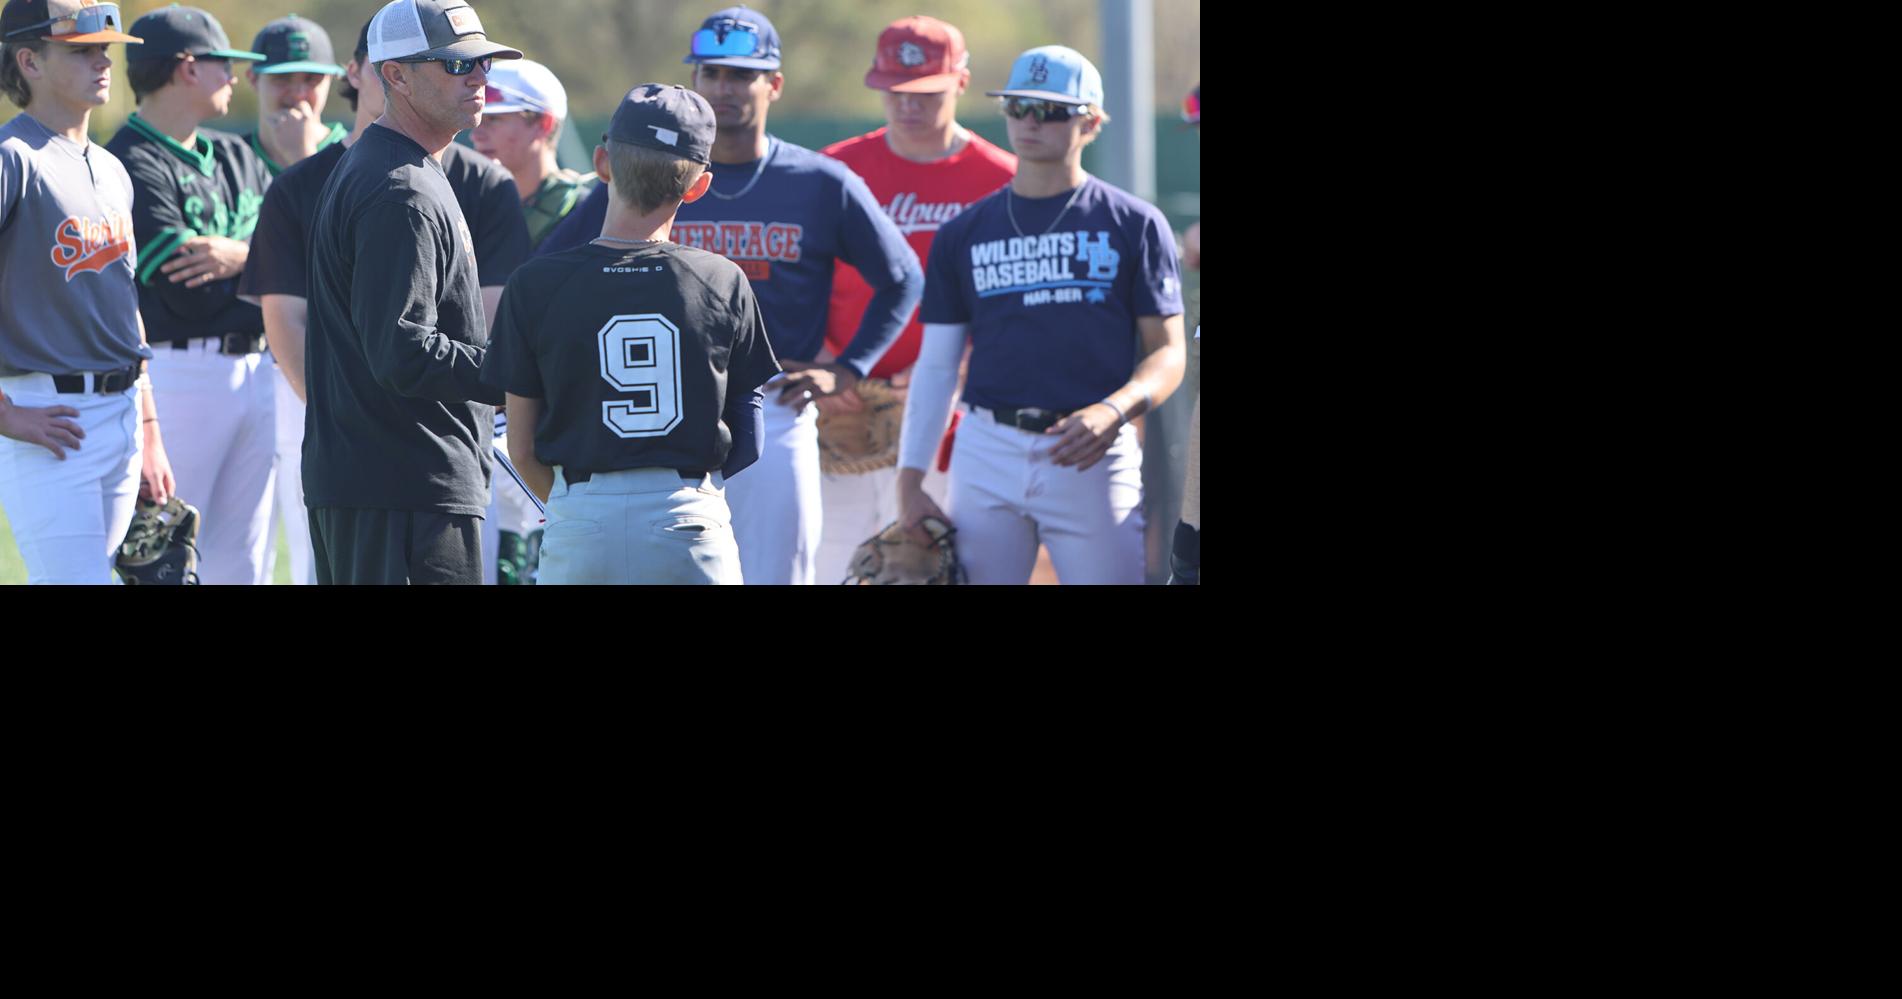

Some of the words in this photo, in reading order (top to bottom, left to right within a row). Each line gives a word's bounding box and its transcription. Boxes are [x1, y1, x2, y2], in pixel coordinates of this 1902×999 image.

[971, 232, 1075, 267] WILDCATS
[972, 256, 1075, 292] BASEBALL
[1023, 287, 1083, 306] HAR-BER
[597, 313, 684, 438] 9
